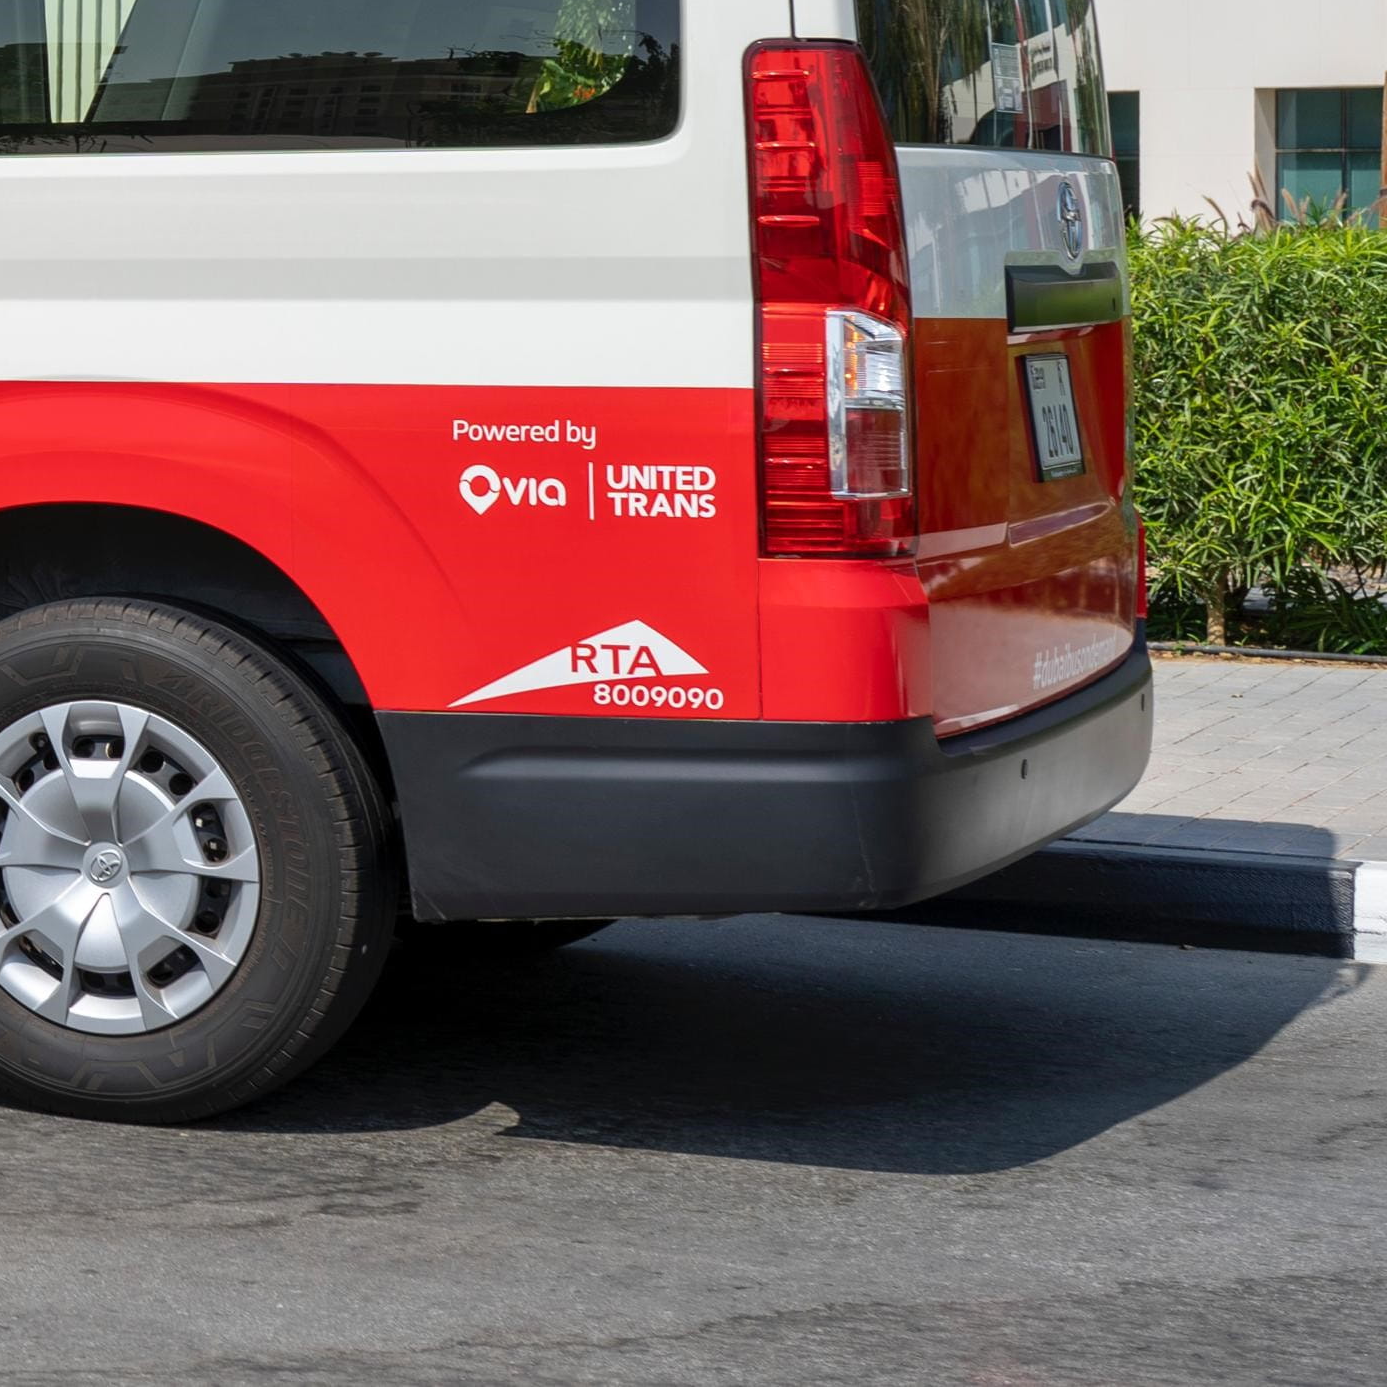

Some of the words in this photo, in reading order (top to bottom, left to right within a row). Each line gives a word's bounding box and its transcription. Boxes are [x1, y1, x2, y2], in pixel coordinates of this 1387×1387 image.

[452, 420, 559, 442] Powered
[567, 420, 596, 450] by
[606, 465, 716, 491] UNITED
[606, 492, 716, 518] TRANS
[569, 643, 663, 677] RTA
[593, 684, 724, 710] 8009090
